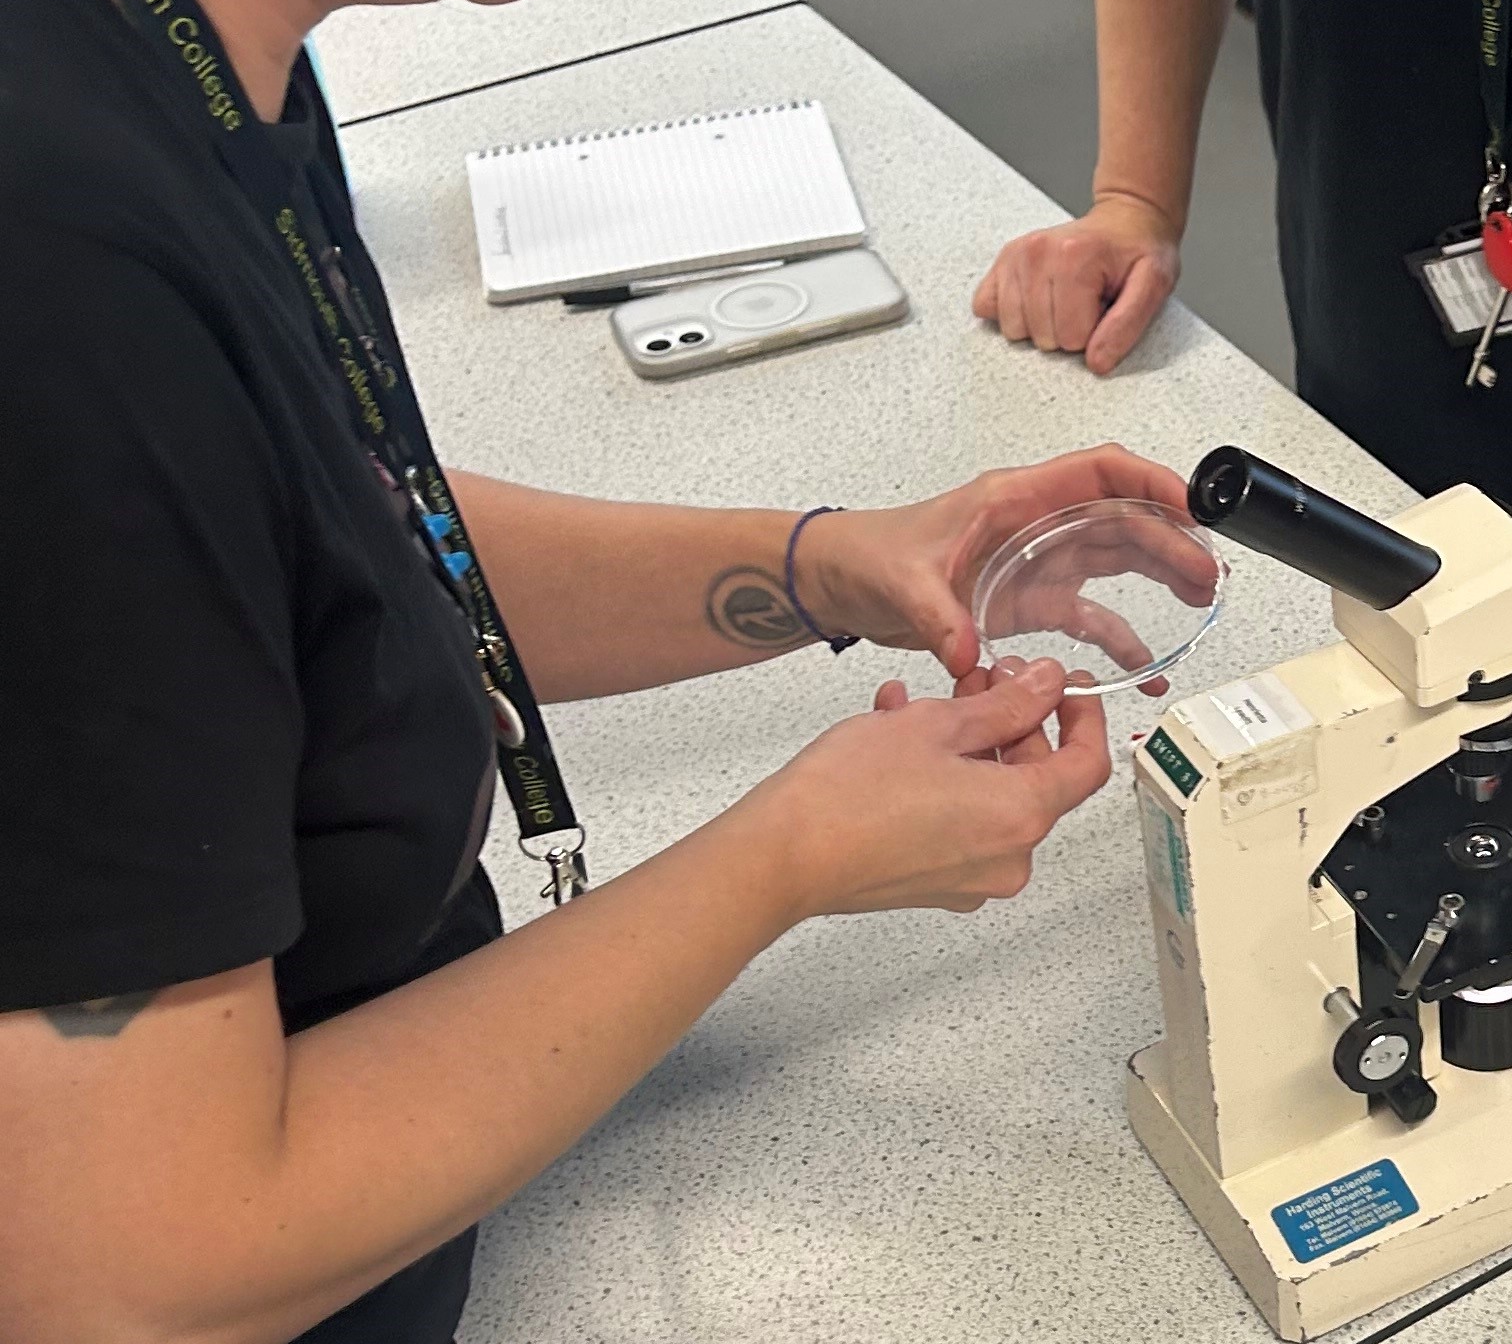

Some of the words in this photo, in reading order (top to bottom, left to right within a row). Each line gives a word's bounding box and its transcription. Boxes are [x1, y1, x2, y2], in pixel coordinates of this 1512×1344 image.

[167, 17, 243, 131] College
[1285, 1192, 1332, 1217] Harding
[1330, 1168, 1383, 1197] Scientific
[1306, 1184, 1373, 1219] Instruments
